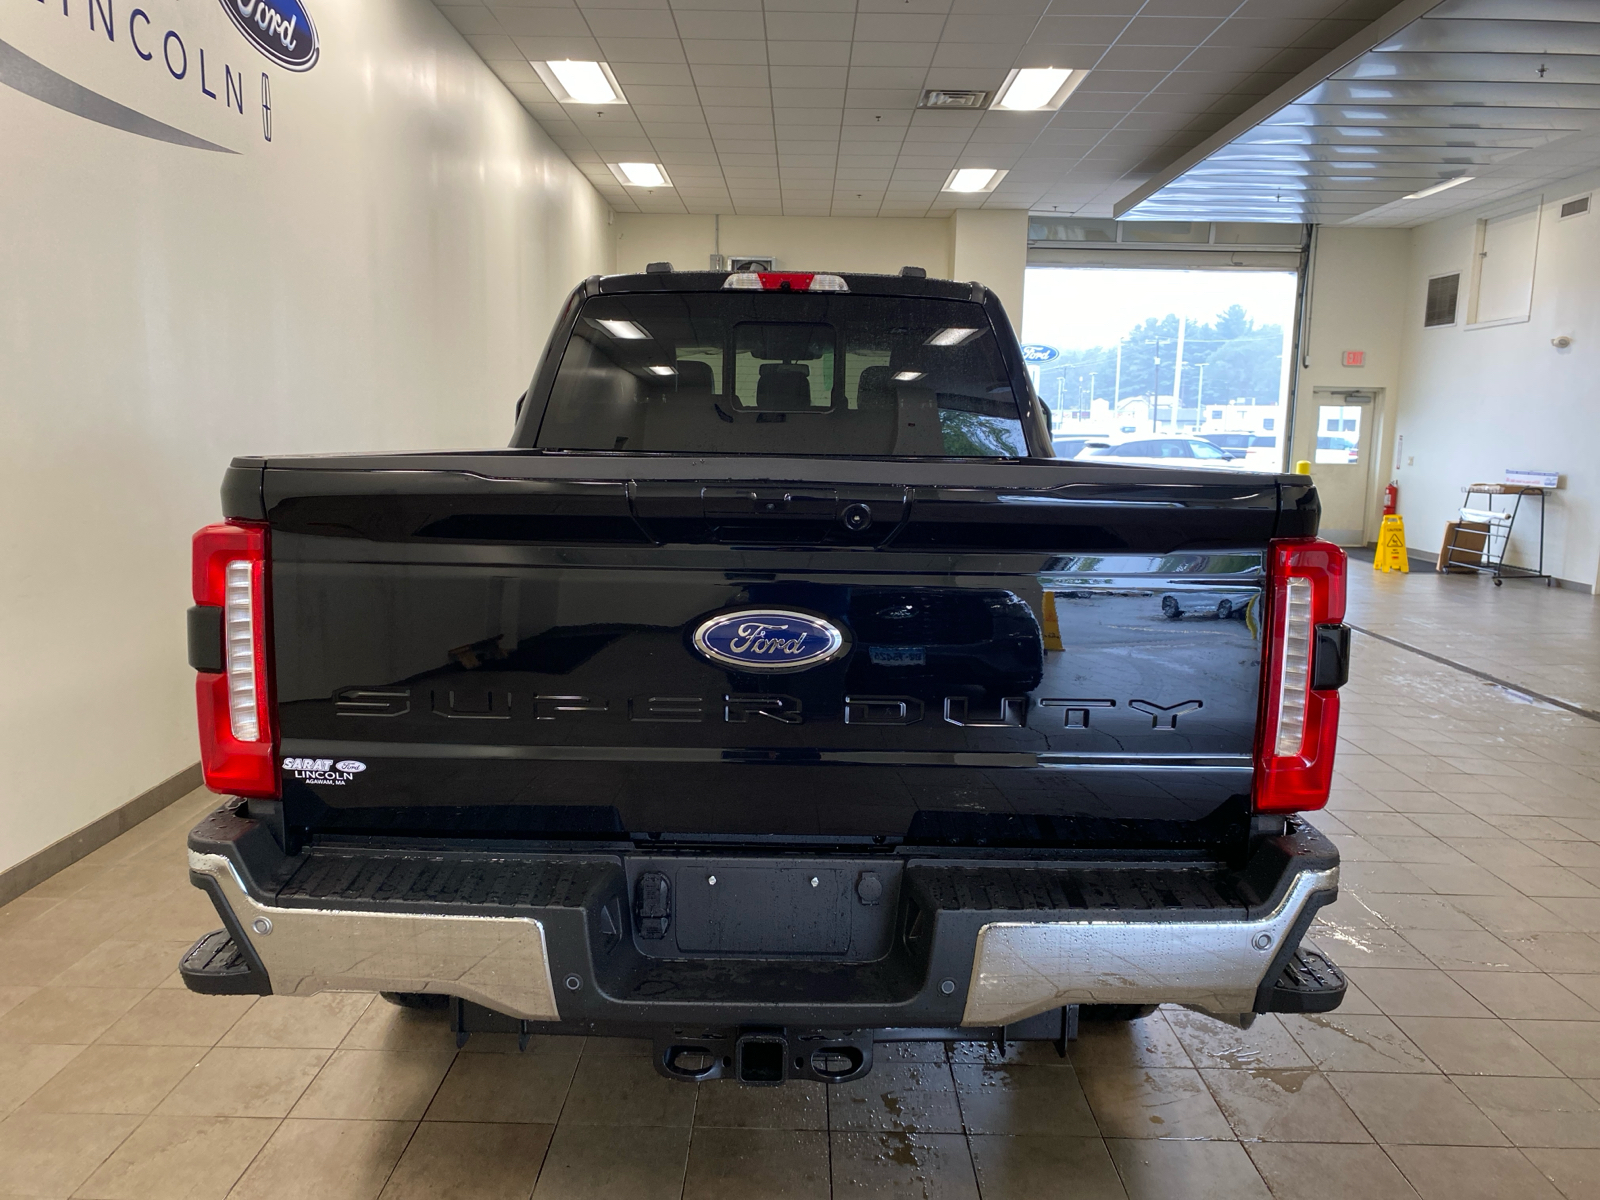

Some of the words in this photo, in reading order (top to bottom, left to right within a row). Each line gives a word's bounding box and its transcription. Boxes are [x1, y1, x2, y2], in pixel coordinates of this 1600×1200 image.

[37, 0, 243, 115] NCOLN
[1023, 346, 1051, 360] Ford
[1346, 351, 1364, 365] EXIT
[730, 622, 808, 655] Ford
[332, 686, 803, 724] SUPER
[844, 695, 1203, 730] DUTY
[282, 757, 334, 771] SARAT
[341, 762, 361, 771] Ford
[294, 770, 354, 780] LINCOLN
